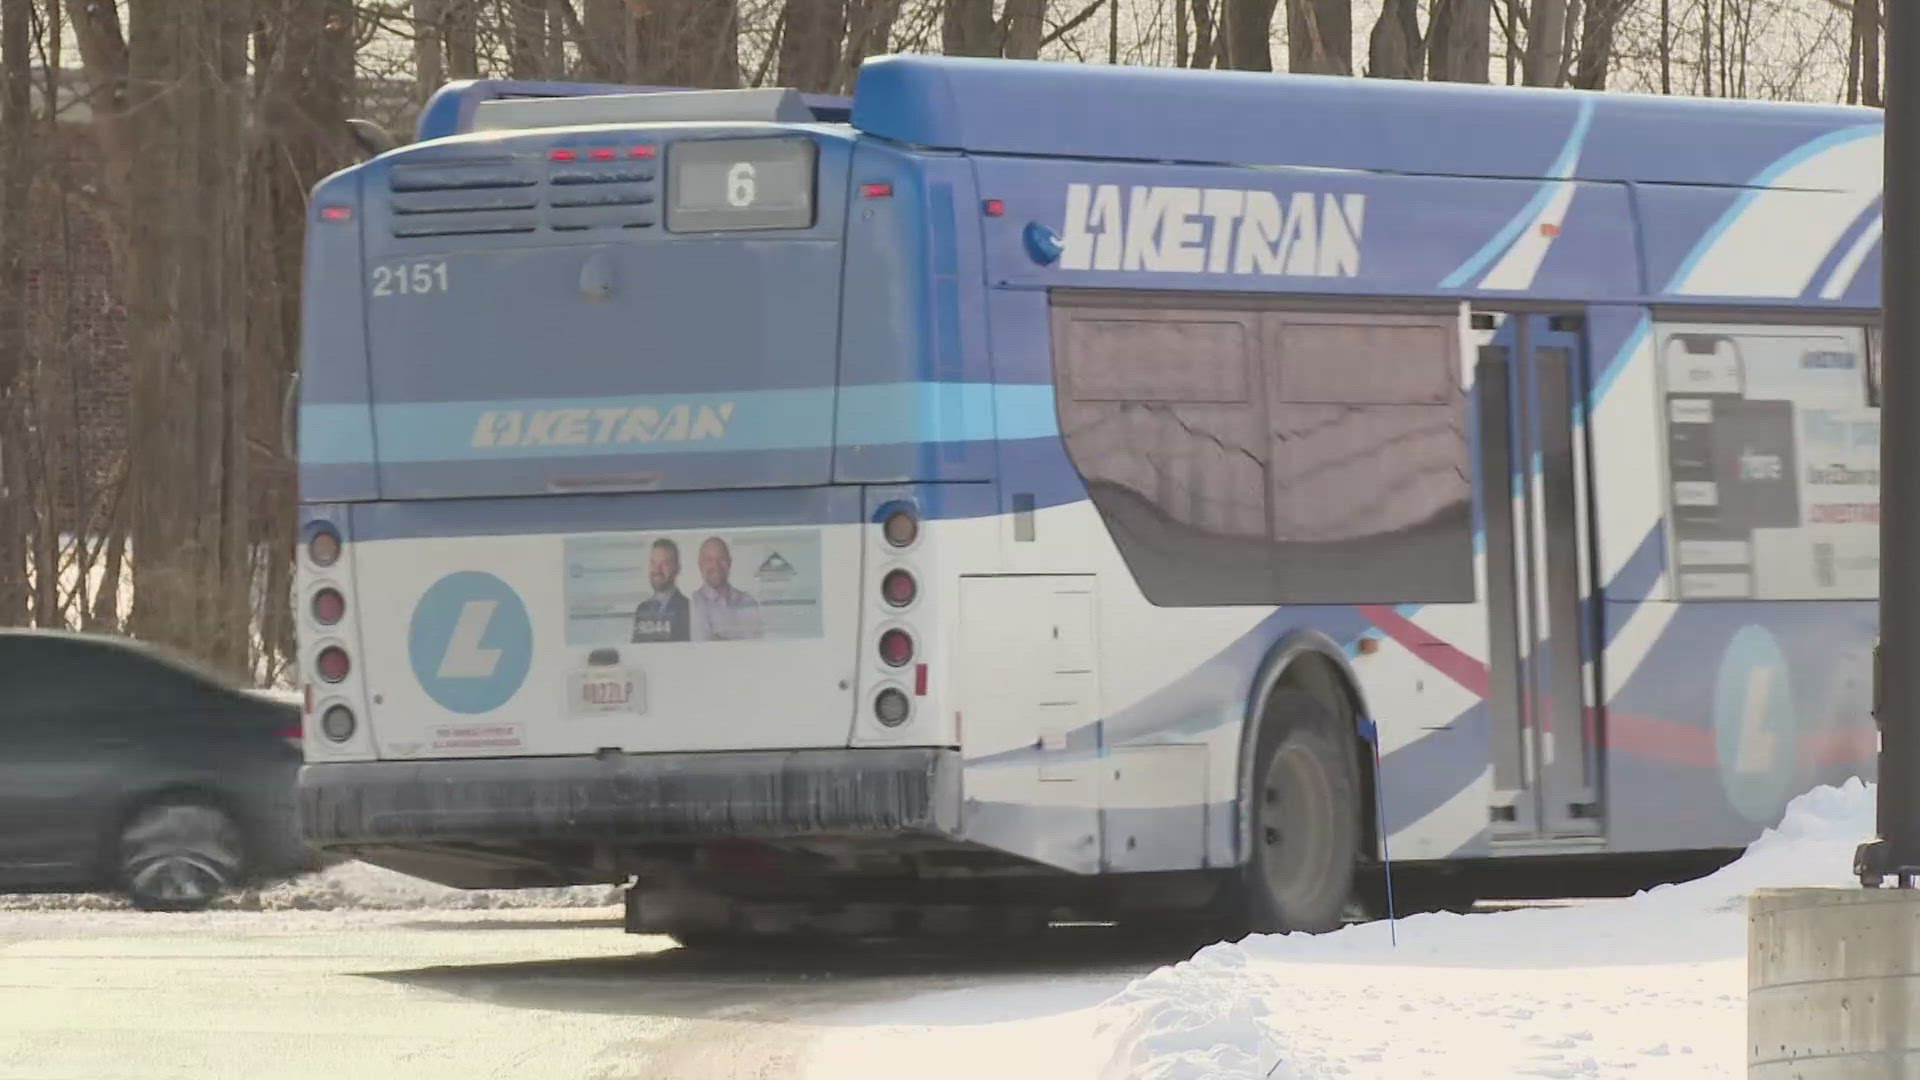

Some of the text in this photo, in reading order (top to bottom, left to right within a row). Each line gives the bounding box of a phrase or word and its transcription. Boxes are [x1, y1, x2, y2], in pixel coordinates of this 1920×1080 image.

[726, 162, 757, 208] 6
[1059, 183, 1367, 277] LAKETRAN
[372, 262, 448, 297] 2151
[471, 402, 735, 449] LAKETRAN
[436, 599, 504, 678] L
